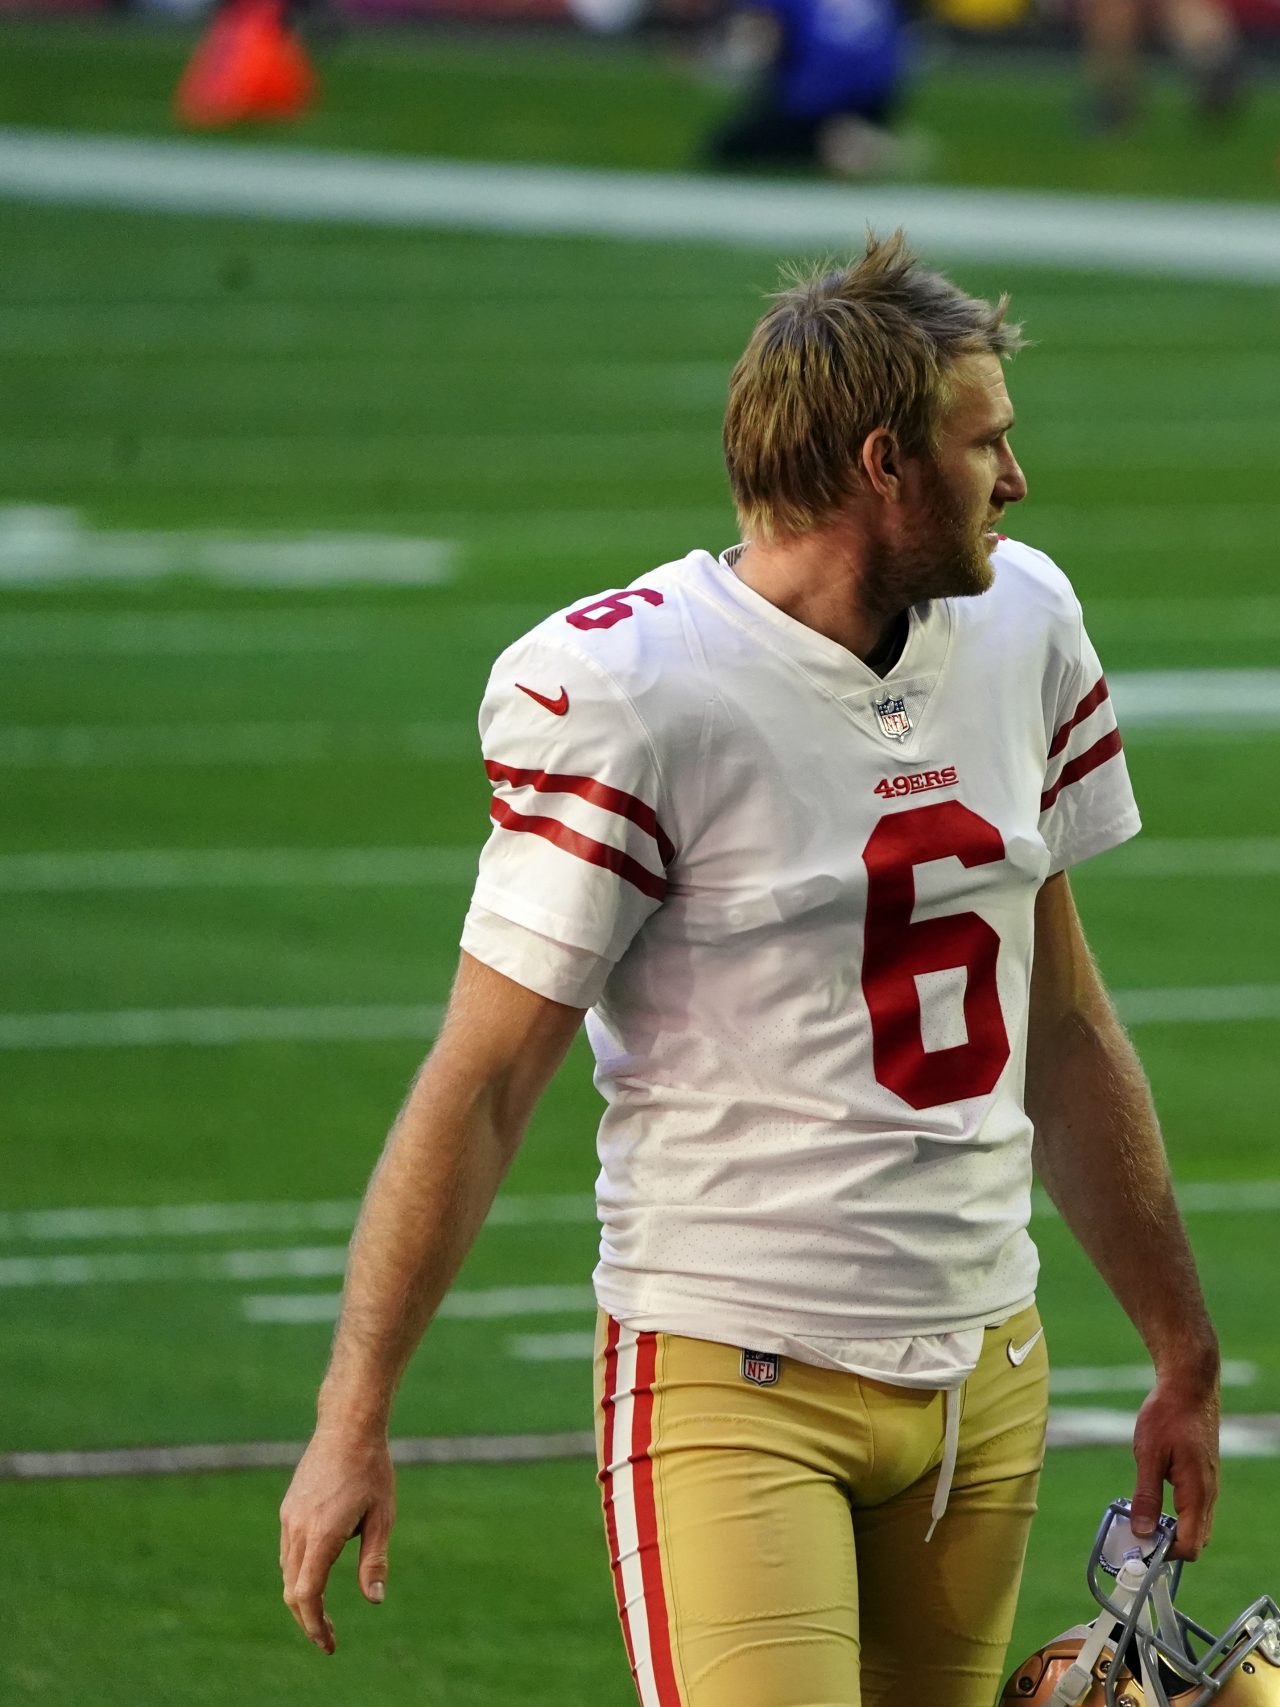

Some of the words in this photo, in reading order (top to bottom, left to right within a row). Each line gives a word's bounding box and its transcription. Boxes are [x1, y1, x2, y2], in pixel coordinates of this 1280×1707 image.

[565, 588, 664, 631] 6
[884, 713, 909, 732] NFL
[873, 766, 959, 799] 49ERS
[861, 799, 1011, 1111] 6
[747, 1360, 773, 1380] NFL
